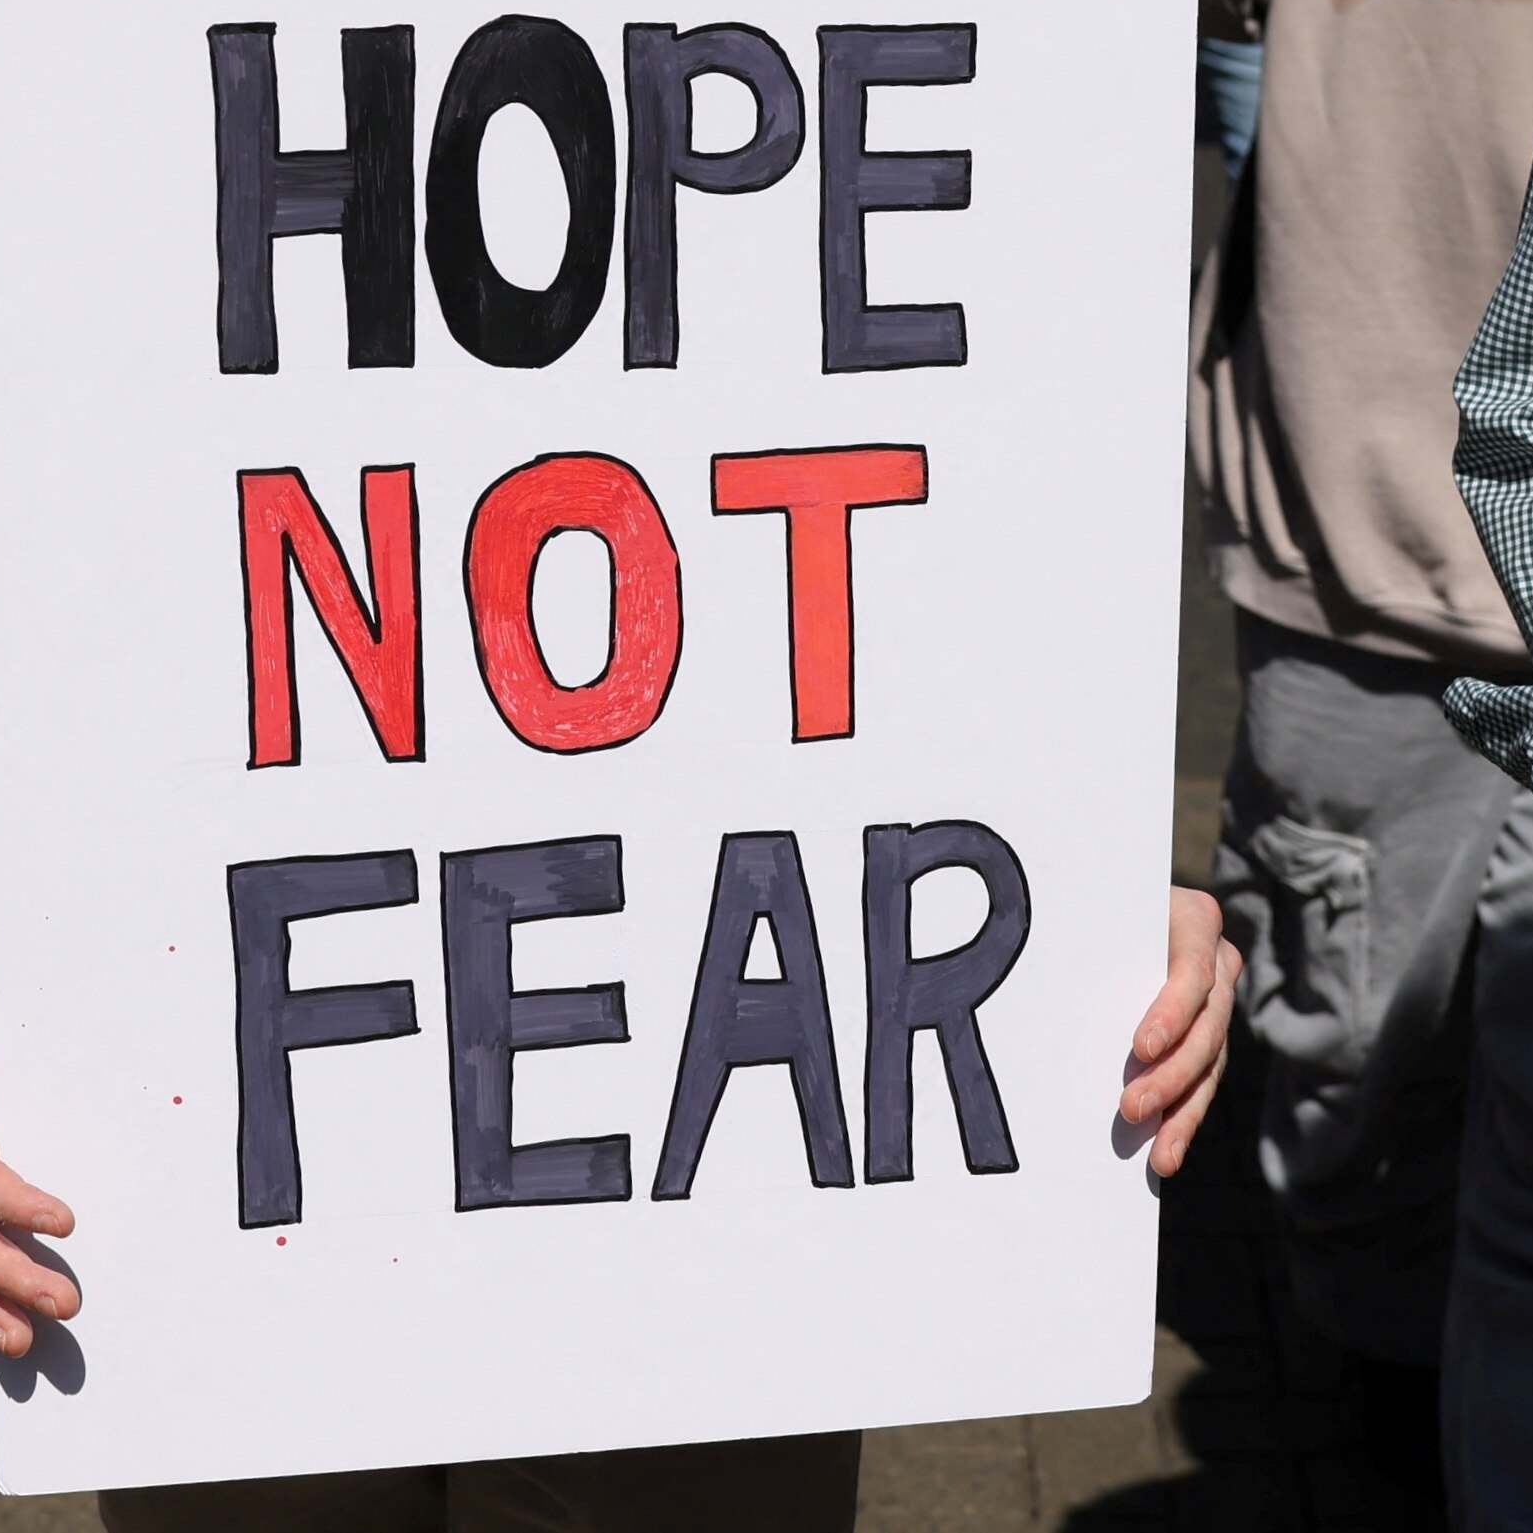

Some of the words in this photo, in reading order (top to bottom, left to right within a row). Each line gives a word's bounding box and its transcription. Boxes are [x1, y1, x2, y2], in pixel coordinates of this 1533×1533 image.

[206, 13, 979, 376] HOPE
[236, 444, 929, 769] NOT
[225, 818, 1033, 1230] FEAR
